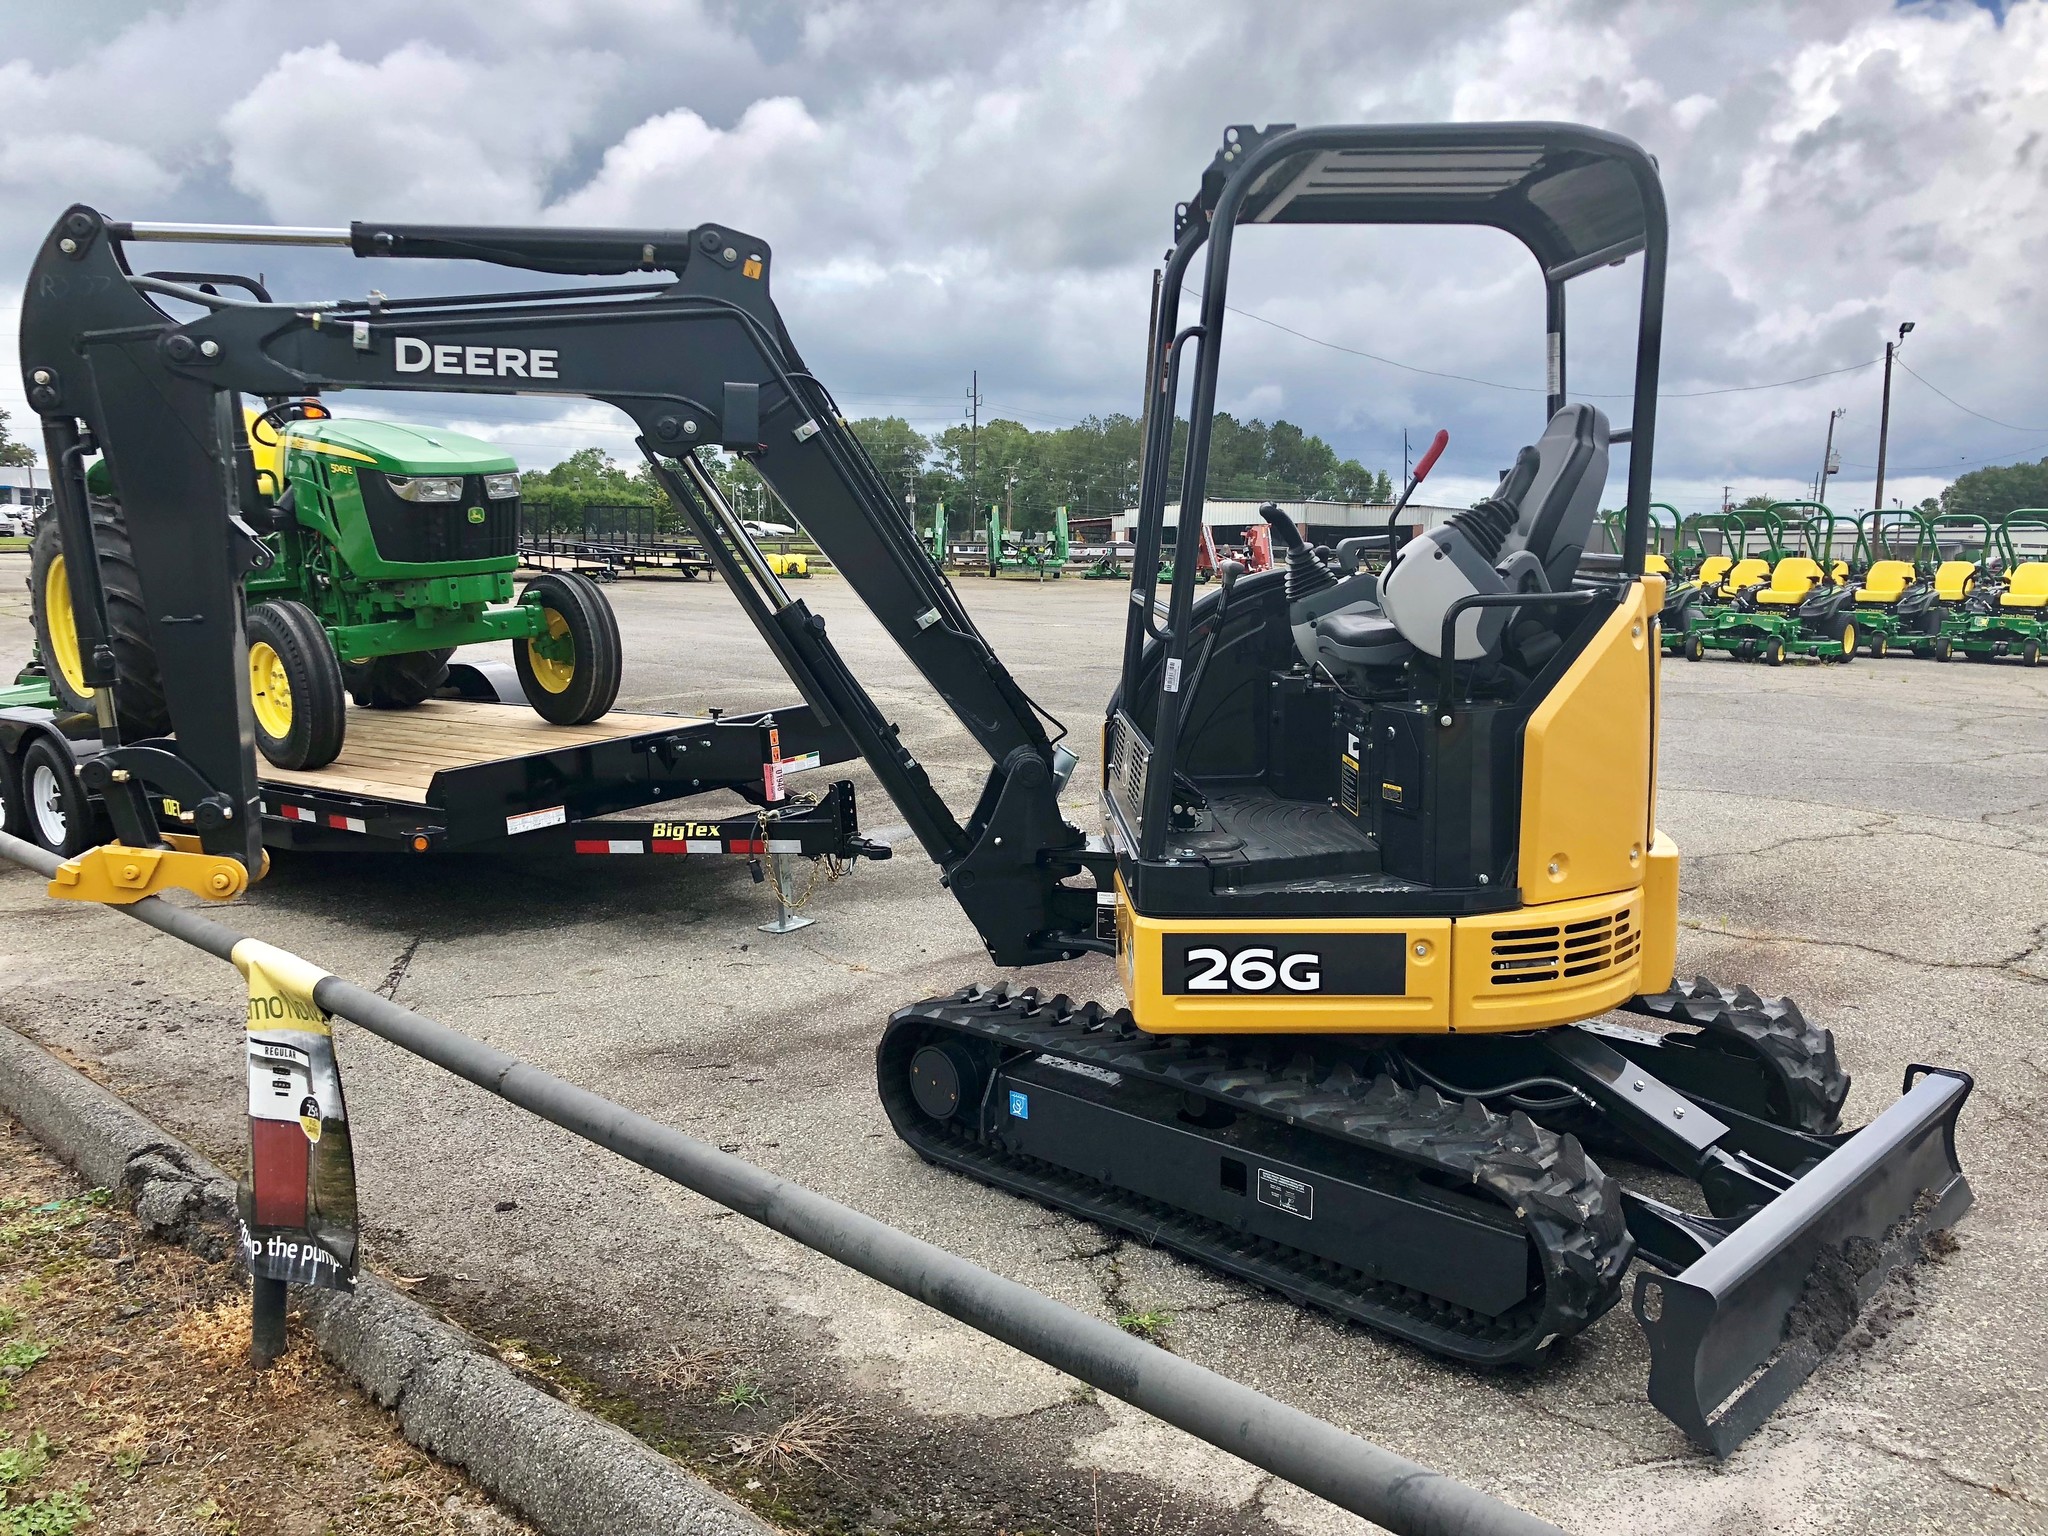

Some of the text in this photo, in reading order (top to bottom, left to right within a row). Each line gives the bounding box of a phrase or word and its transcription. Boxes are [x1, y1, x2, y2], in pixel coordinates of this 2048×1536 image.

[395, 336, 559, 379] DEERE
[652, 823, 721, 841] BigTex
[1188, 948, 1321, 991] 26G
[264, 1046, 297, 1060] REGULAR
[267, 1236, 298, 1259] the
